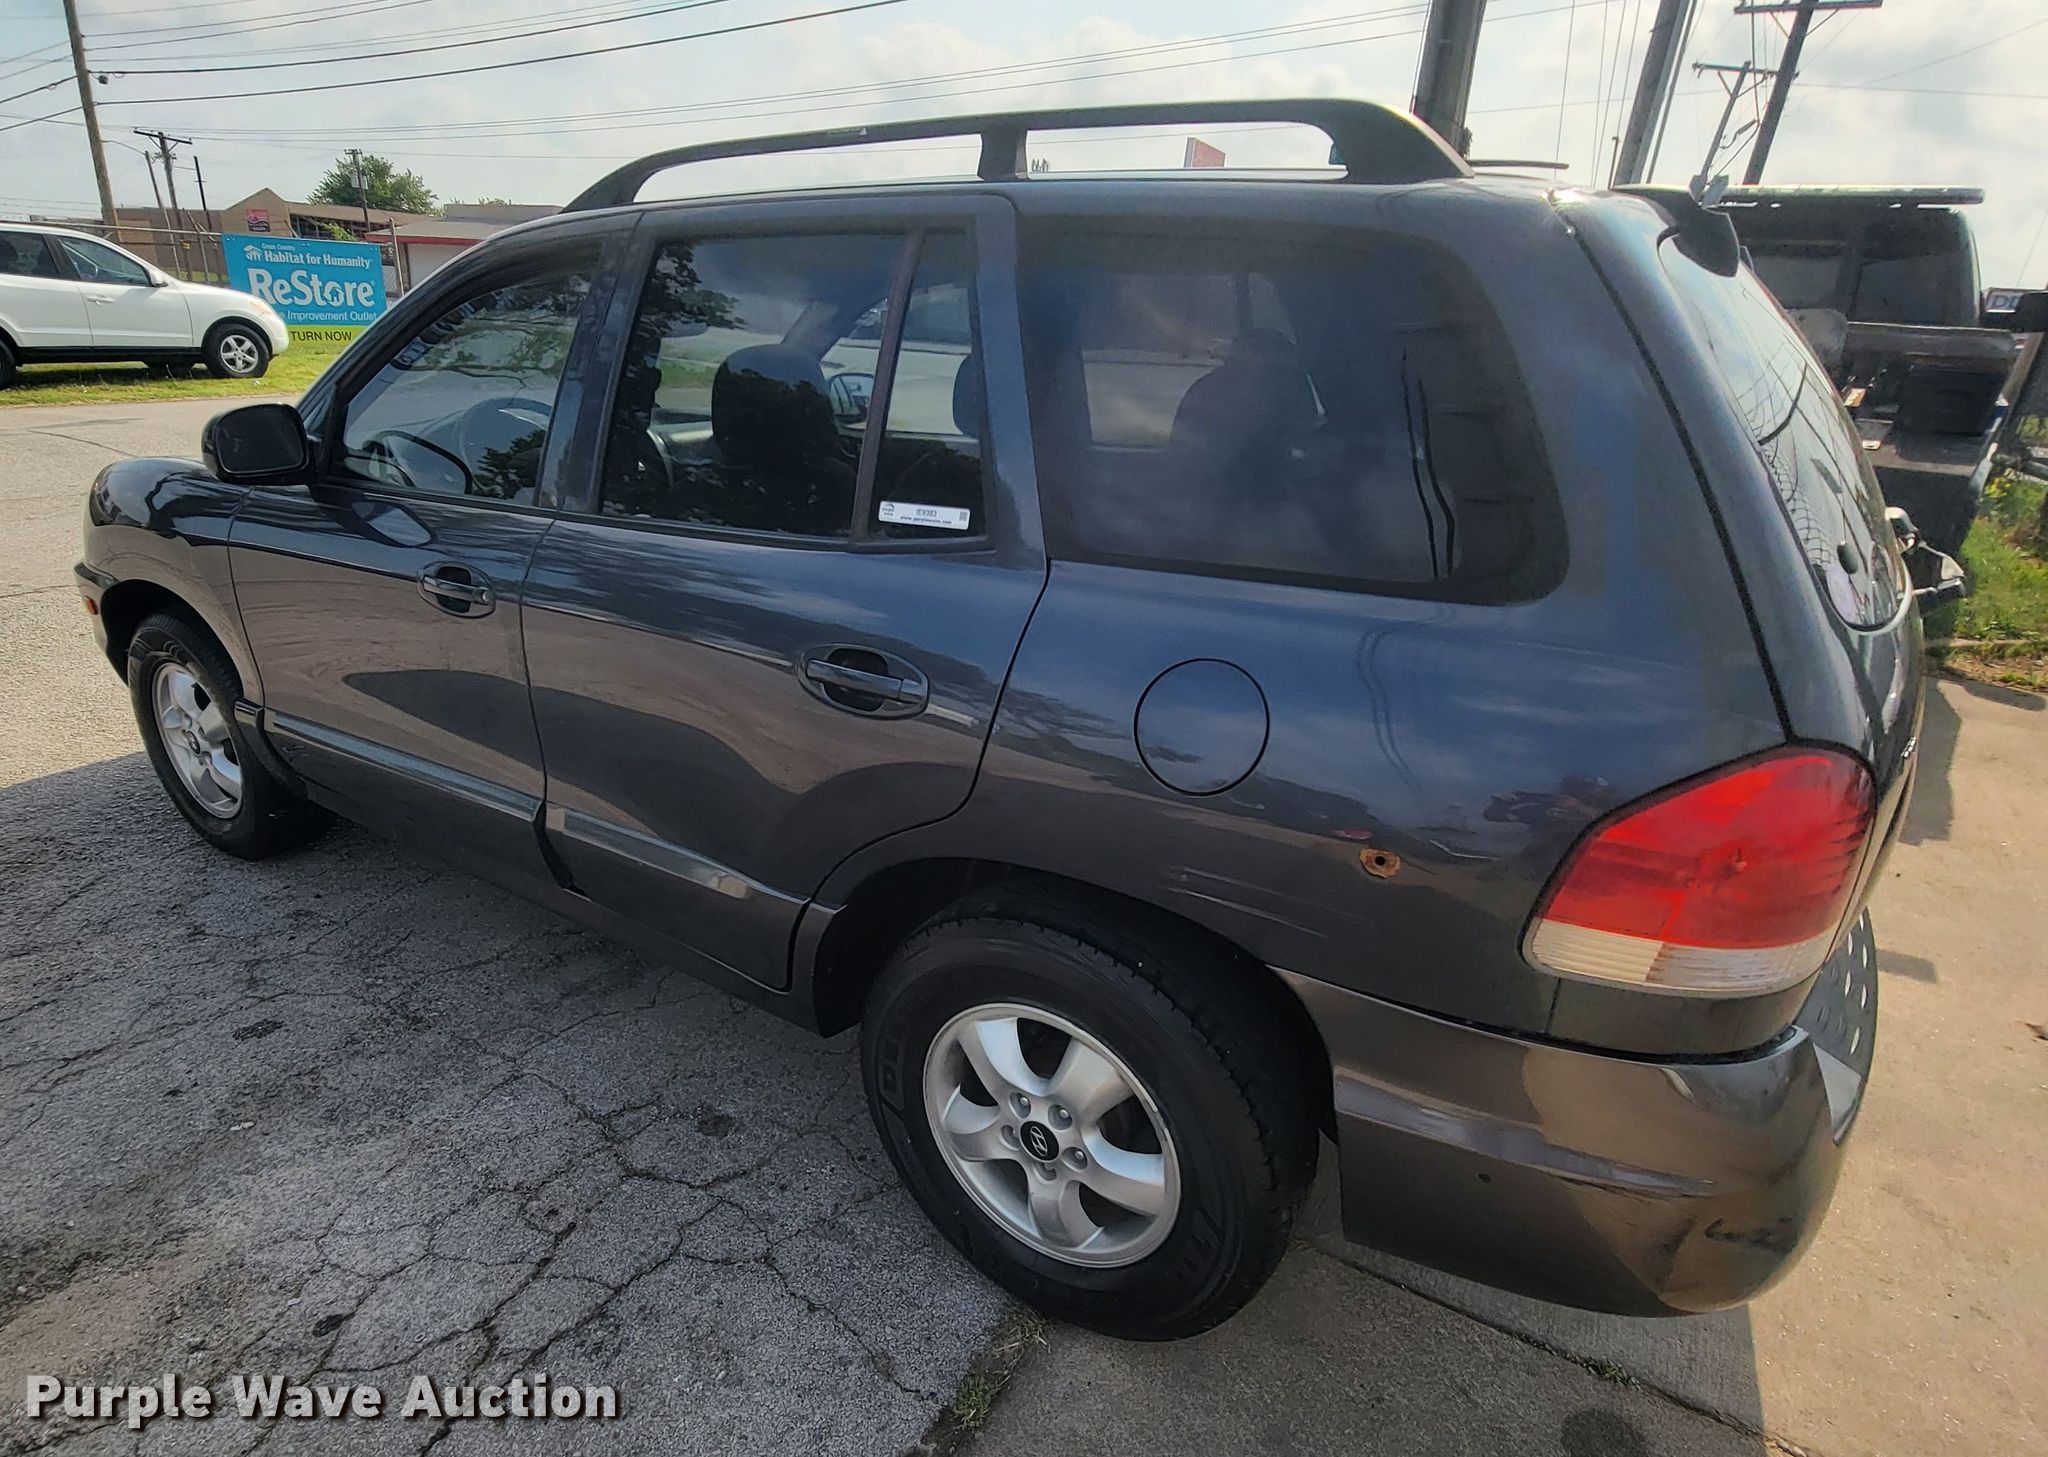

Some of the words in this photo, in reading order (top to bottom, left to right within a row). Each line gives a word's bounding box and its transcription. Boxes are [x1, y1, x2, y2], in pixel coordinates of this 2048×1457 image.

[264, 250, 304, 264] Habitat
[306, 253, 321, 265] for
[323, 254, 370, 269] Humanity
[247, 268, 375, 307] ReStore
[287, 310, 347, 322] Improvement
[350, 311, 377, 321] Outlet
[290, 331, 322, 340] TURN
[325, 331, 352, 341] NOW
